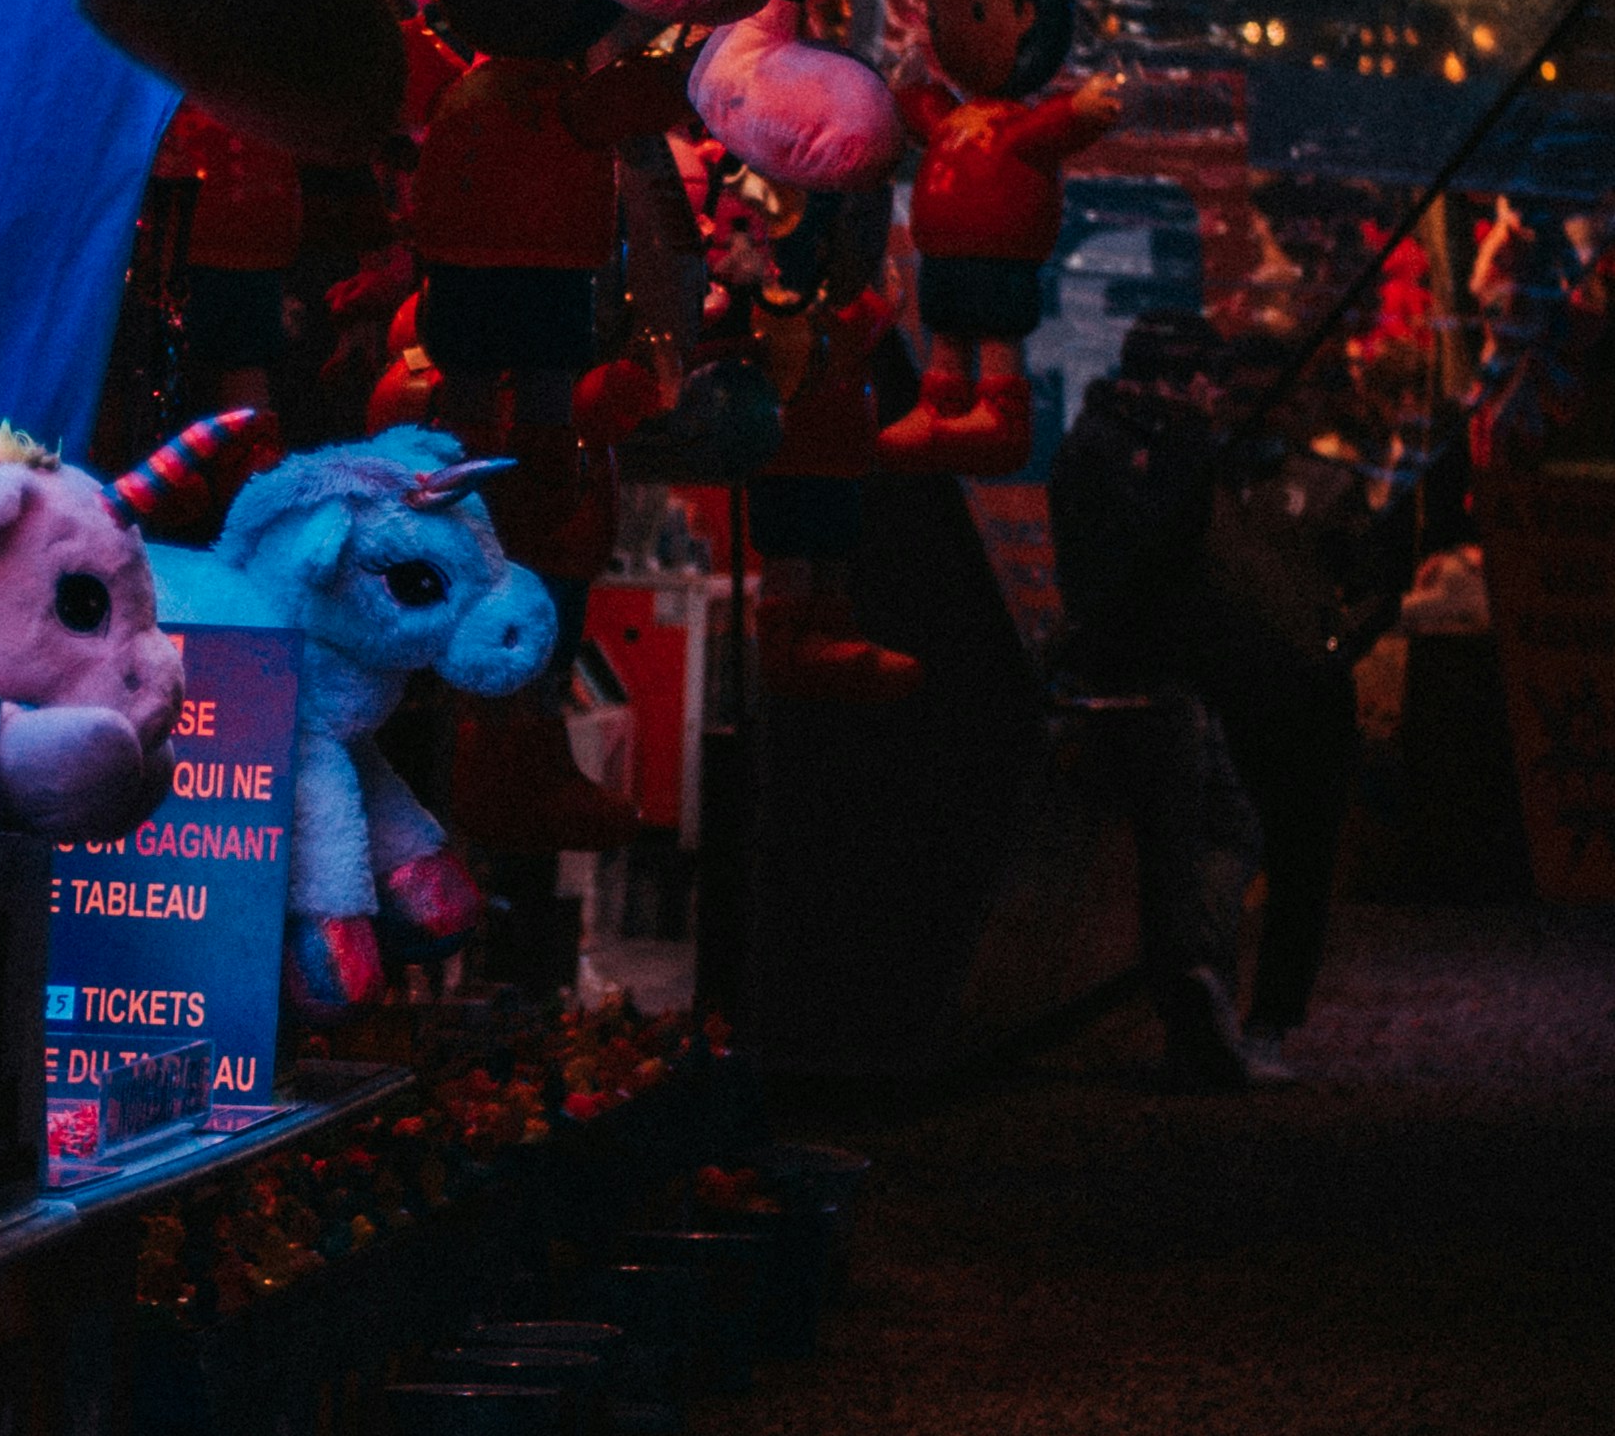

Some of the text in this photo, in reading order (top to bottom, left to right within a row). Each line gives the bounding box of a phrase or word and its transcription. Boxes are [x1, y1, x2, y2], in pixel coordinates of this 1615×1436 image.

[172, 761, 273, 801] QUI NE
[135, 819, 284, 861] GAGNANT
[70, 879, 208, 921] TABLEAU
[81, 986, 206, 1028] TICKETS
[67, 1049, 110, 1085] DU
